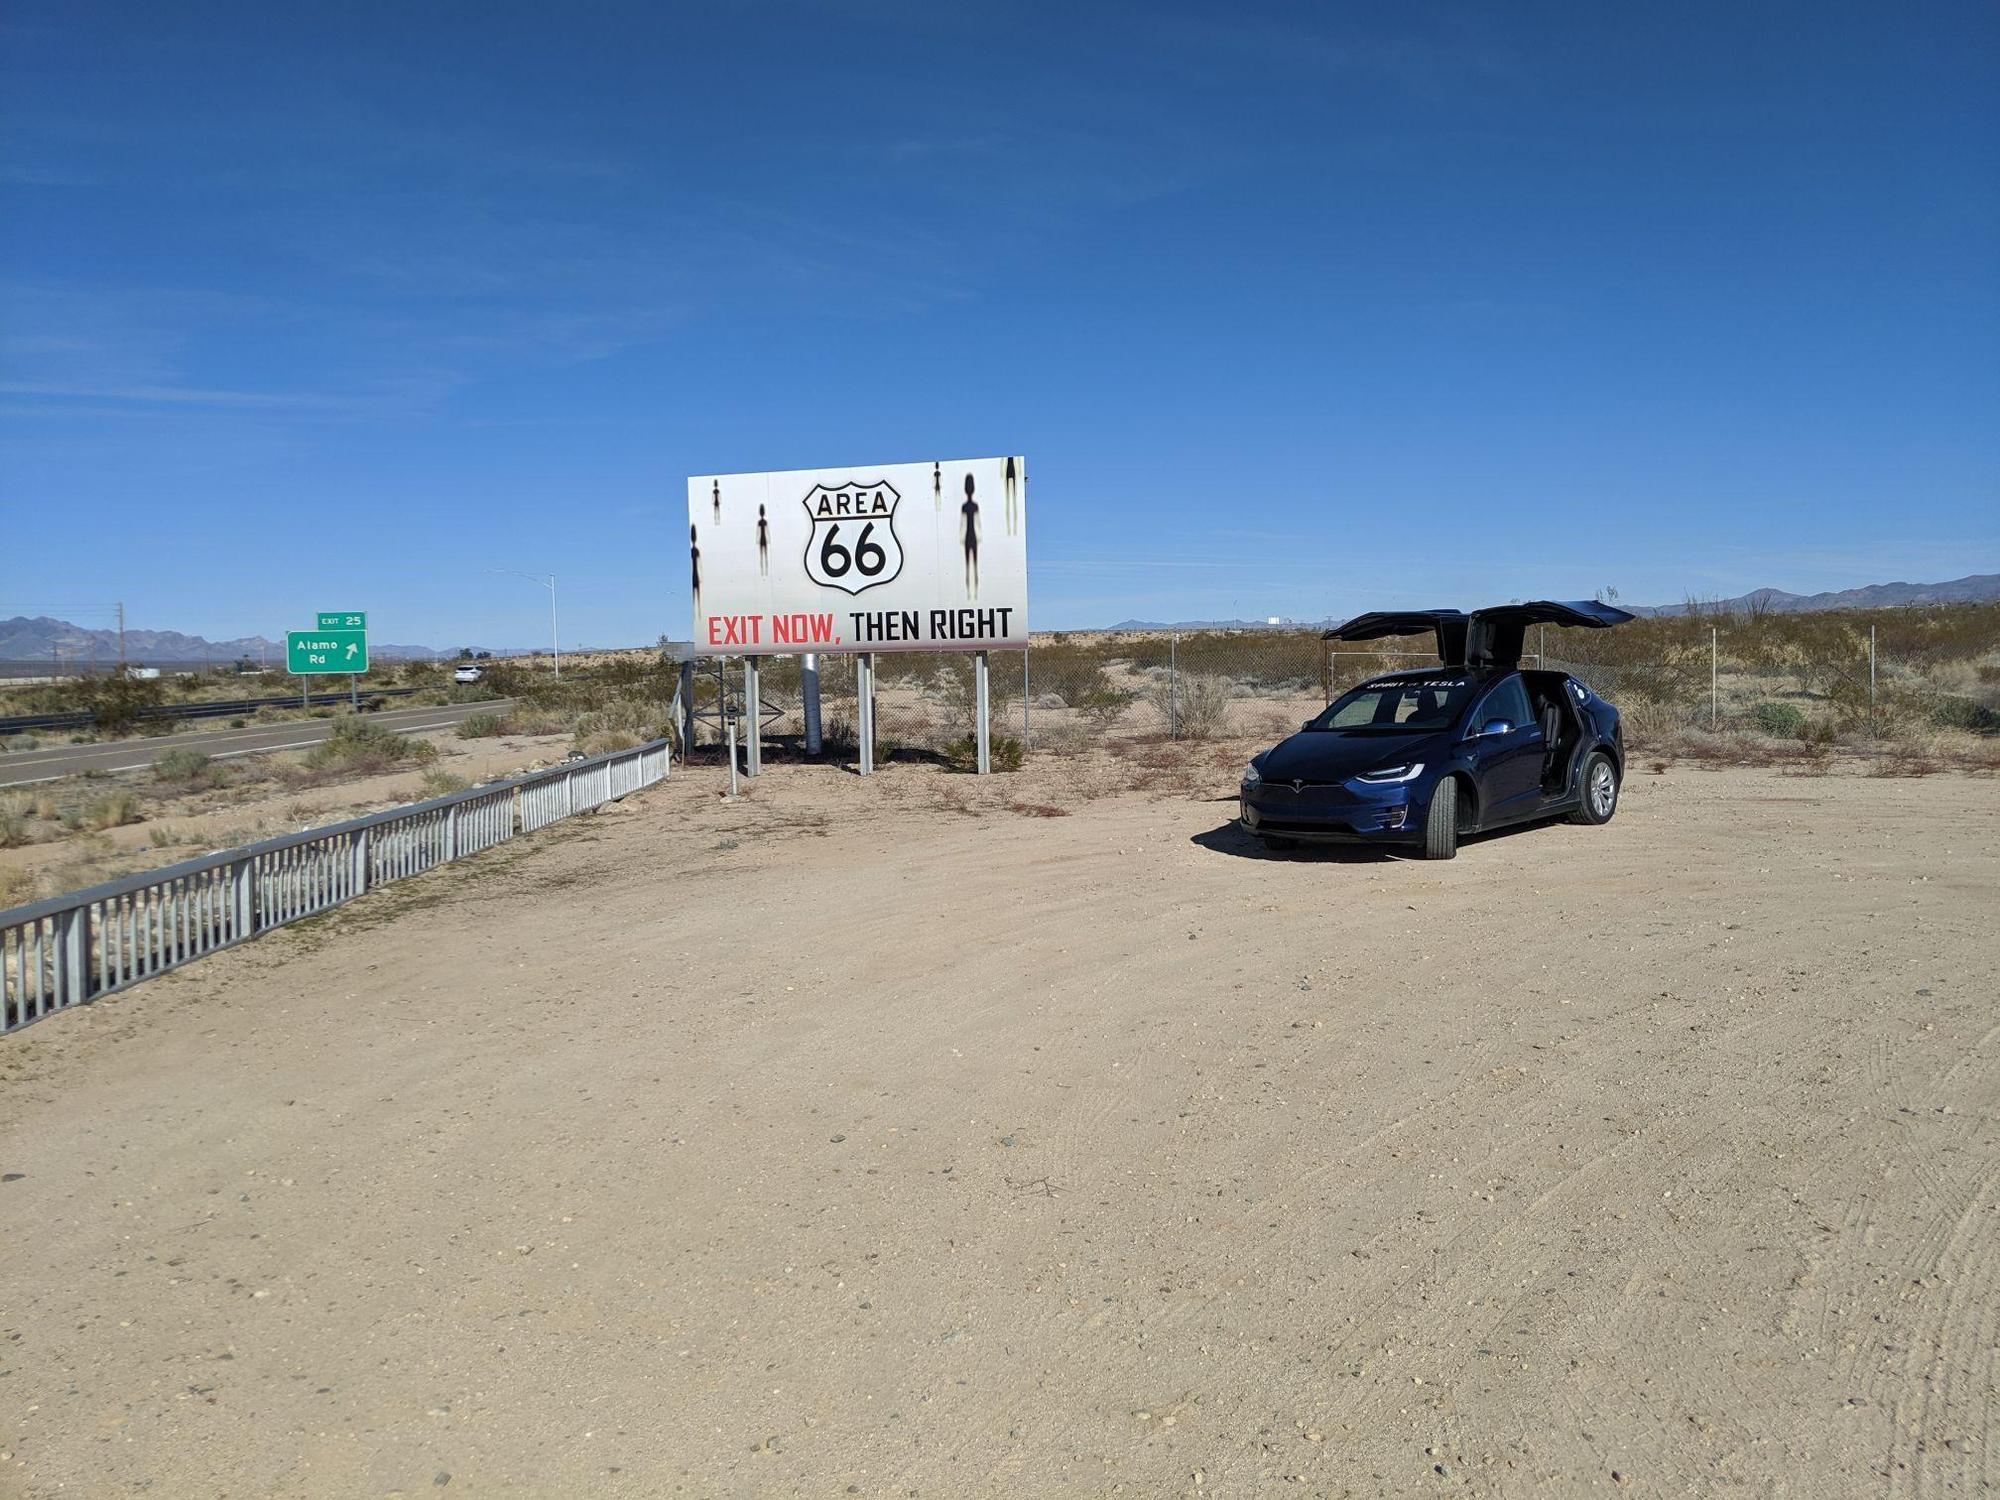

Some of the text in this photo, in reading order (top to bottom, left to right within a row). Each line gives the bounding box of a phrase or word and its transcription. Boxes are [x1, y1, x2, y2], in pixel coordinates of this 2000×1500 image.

[817, 491, 888, 516] AREA
[820, 522, 886, 578] 66
[346, 616, 361, 626] 25
[708, 607, 1013, 646] EXIT NOW, THEN RIGHT
[297, 641, 338, 650] Alamo
[309, 655, 326, 664] Rd
